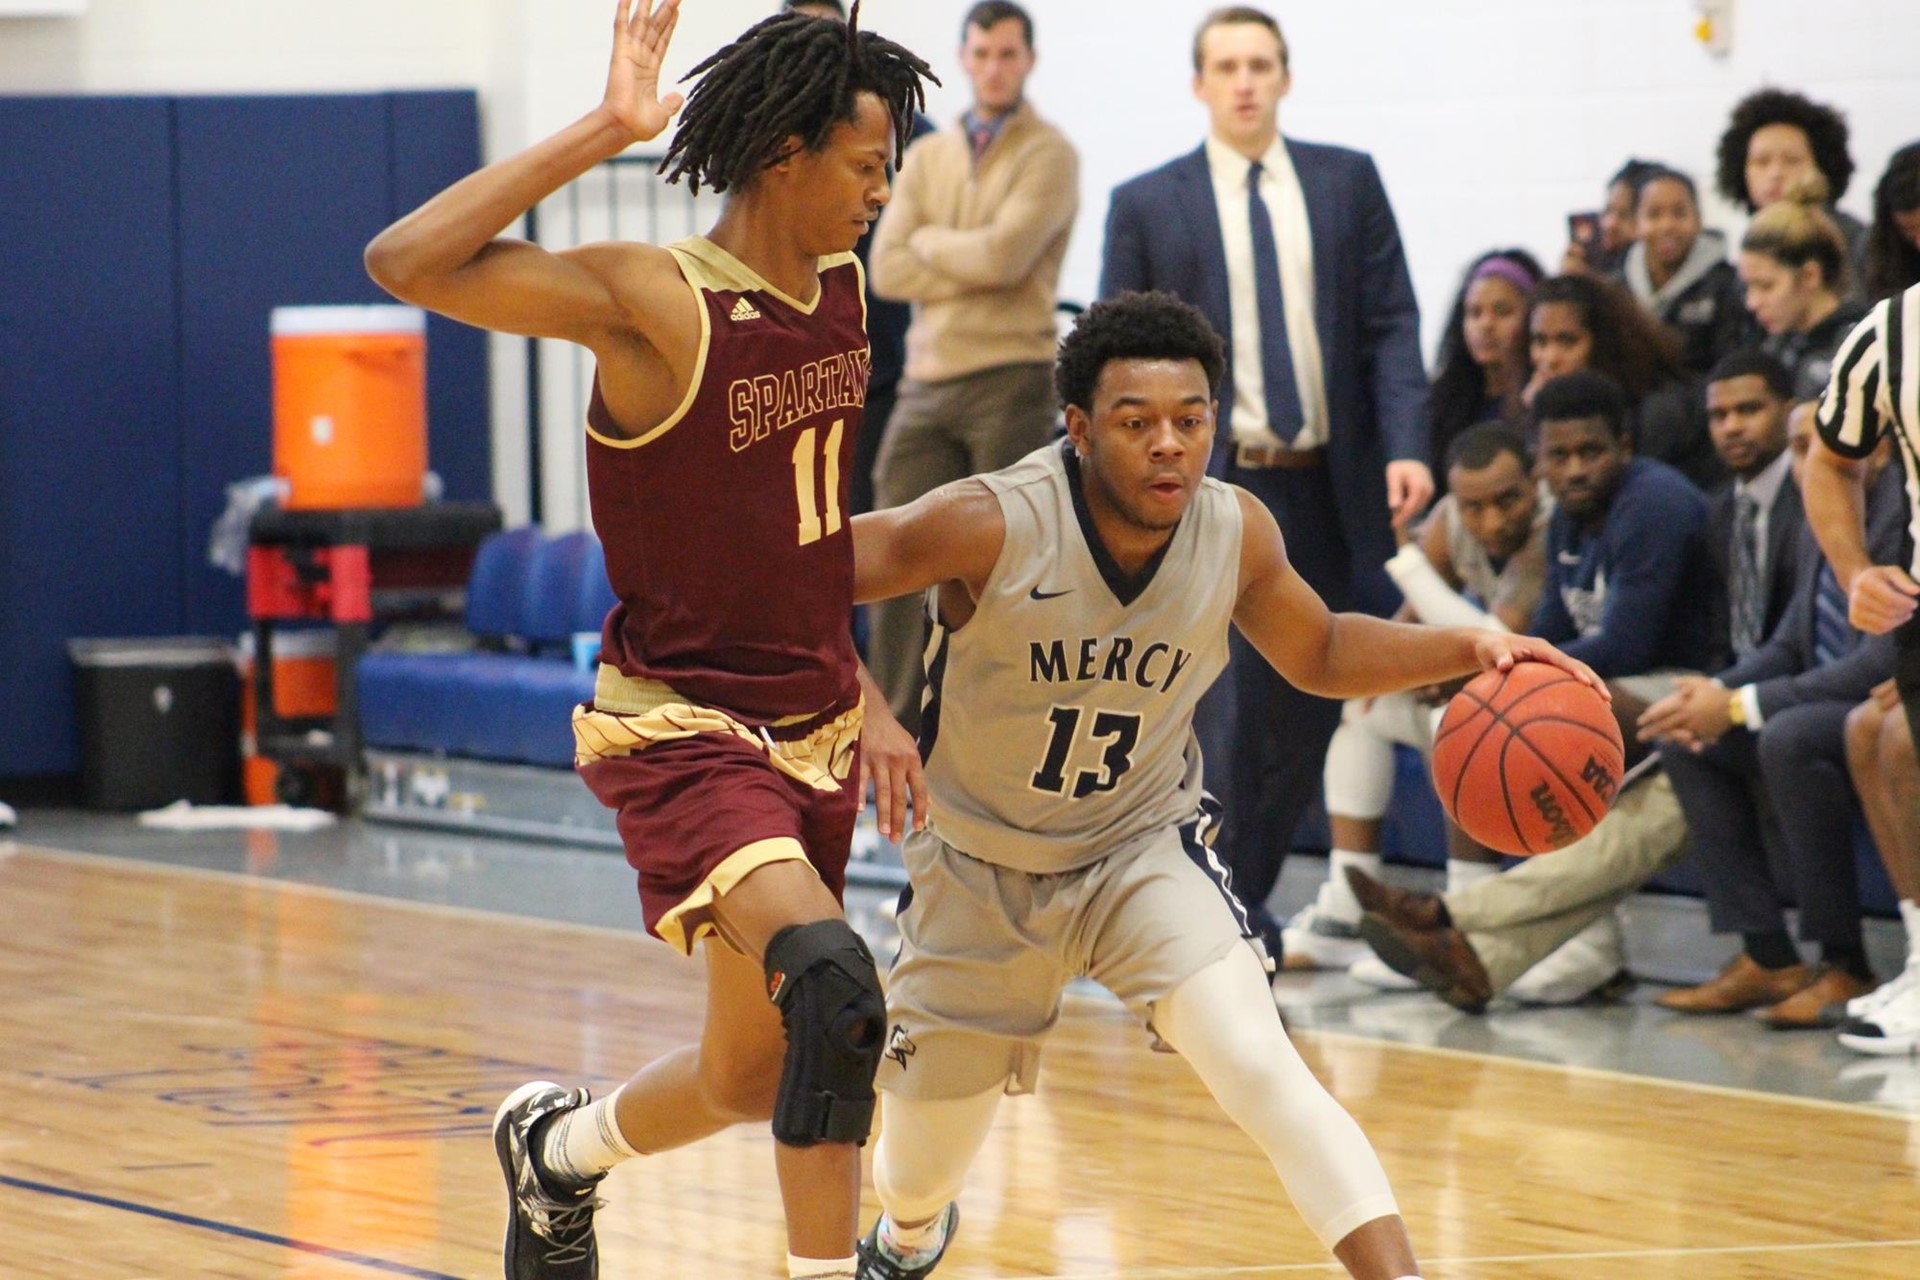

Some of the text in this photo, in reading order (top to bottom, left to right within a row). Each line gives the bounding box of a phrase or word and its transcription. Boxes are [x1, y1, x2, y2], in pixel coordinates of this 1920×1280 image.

[728, 347, 873, 453] SPARTAN
[791, 418, 844, 546] 11
[1029, 636, 1192, 693] MERCY
[1029, 703, 1142, 801] 13
